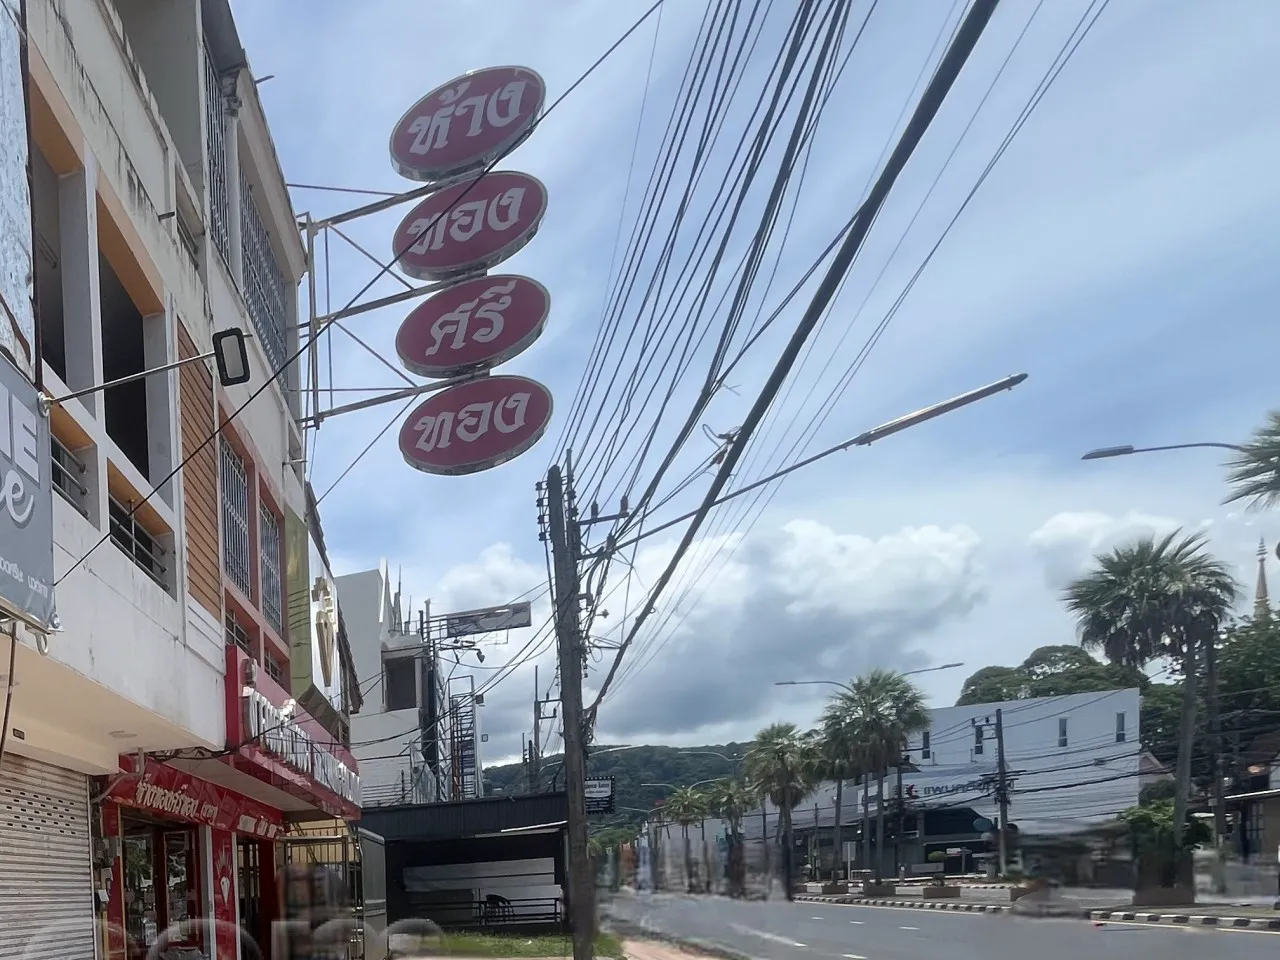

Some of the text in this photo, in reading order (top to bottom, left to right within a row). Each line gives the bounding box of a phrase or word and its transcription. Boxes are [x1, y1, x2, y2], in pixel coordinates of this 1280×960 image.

[407, 80, 528, 156] ห้าง
[406, 187, 526, 256] ทอง
[424, 280, 518, 358] ศรี
[412, 391, 532, 453] ทอง
